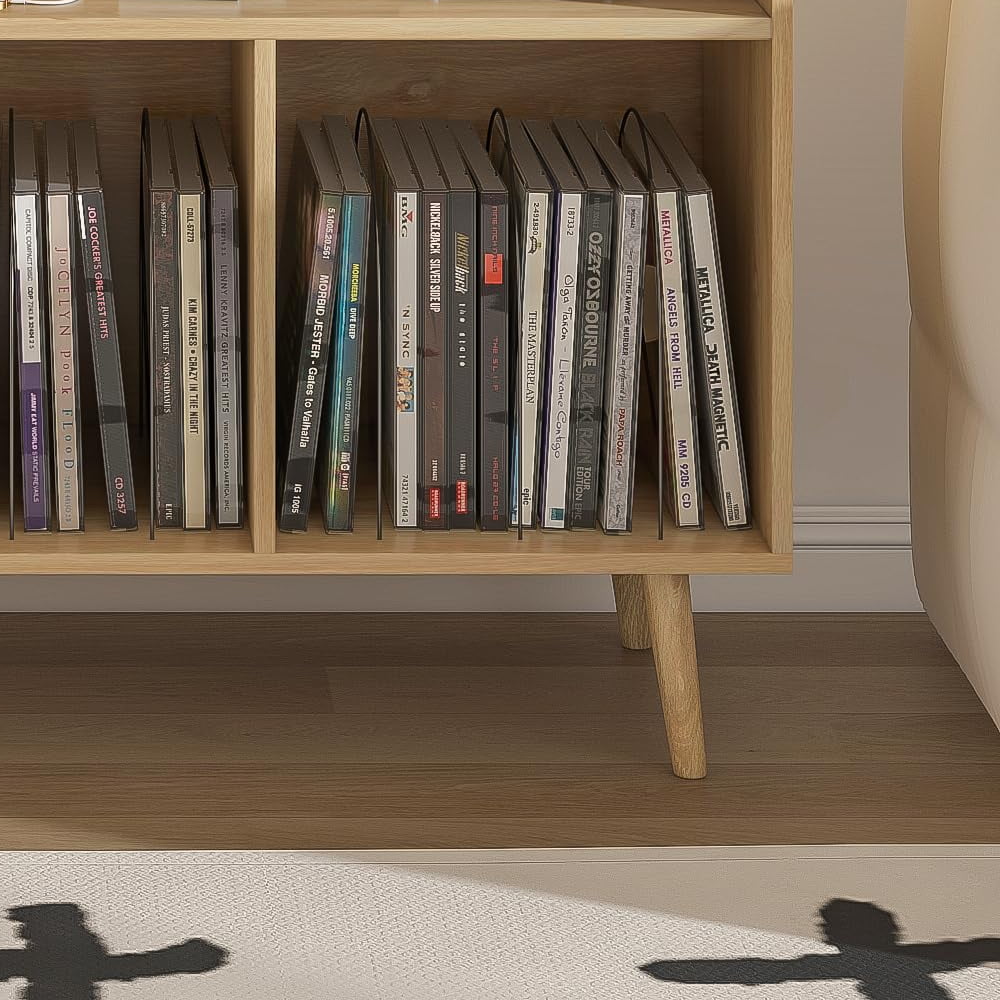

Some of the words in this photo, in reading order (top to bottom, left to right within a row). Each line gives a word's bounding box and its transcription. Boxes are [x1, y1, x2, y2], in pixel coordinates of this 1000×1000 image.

[87, 206, 98, 224] JOE
[566, 208, 576, 236] 18733-2
[429, 203, 441, 254] NICKELBACK
[661, 211, 674, 265] METALLICA
[89, 226, 102, 269] COCKER'S
[587, 232, 603, 277] OZZY
[220, 265, 228, 295] LENNY
[350, 264, 360, 302] MORCHEEBA
[430, 259, 441, 284] SILVER
[625, 265, 633, 294] GETTING
[94, 272, 107, 316] GREATEST
[315, 274, 329, 316] MORBID
[430, 285, 440, 301] SIDE
[559, 275, 575, 303] Olga
[696, 267, 715, 333] METALLICA
[161, 306, 170, 328] JUDAS
[188, 298, 198, 313] KIM
[349, 308, 357, 322] DIVE
[430, 303, 440, 312] UP
[624, 296, 632, 316] AWAY
[667, 288, 678, 327] ANGELS
[99, 319, 109, 339] HITS
[188, 316, 198, 346] CARNES
[220, 300, 229, 338] KRAVITZ
[348, 324, 356, 339] DEEP
[528, 311, 537, 331] THE
[582, 277, 601, 368] OSBOURNE
[162, 330, 170, 355] PRIEST
[310, 318, 324, 358] JESTER
[402, 324, 410, 358] SYNC
[622, 327, 630, 355] MURDER
[670, 333, 681, 361] FROM
[188, 356, 198, 381] CRAZY
[220, 342, 229, 388] GREATEST
[525, 334, 537, 404] MASTERPLAN
[705, 344, 722, 384] DEATH
[162, 362, 172, 413] NOSTRADAMUS
[672, 367, 683, 389] HELL
[189, 394, 198, 408] THE
[222, 392, 230, 412] HITS
[304, 398, 313, 407] to
[189, 412, 199, 434] NIGHT
[299, 410, 313, 448] Valhalla
[617, 409, 626, 432] PAPA
[711, 388, 730, 451] MAGNETIC
[551, 410, 567, 458] Contigo
[616, 434, 624, 466] ROACH
[677, 440, 688, 458] MM
[114, 477, 124, 490] CD
[293, 484, 302, 492] IG
[401, 475, 409, 495] 74321
[575, 466, 584, 500] EDITION
[583, 466, 592, 490] TOUR
[679, 464, 690, 488] 9205
[116, 492, 127, 514] 3257
[291, 496, 301, 514] 1005
[401, 497, 409, 516] 47164
[521, 488, 532, 506] epic
[682, 493, 692, 508] CD
[574, 503, 582, 520] EPIC
